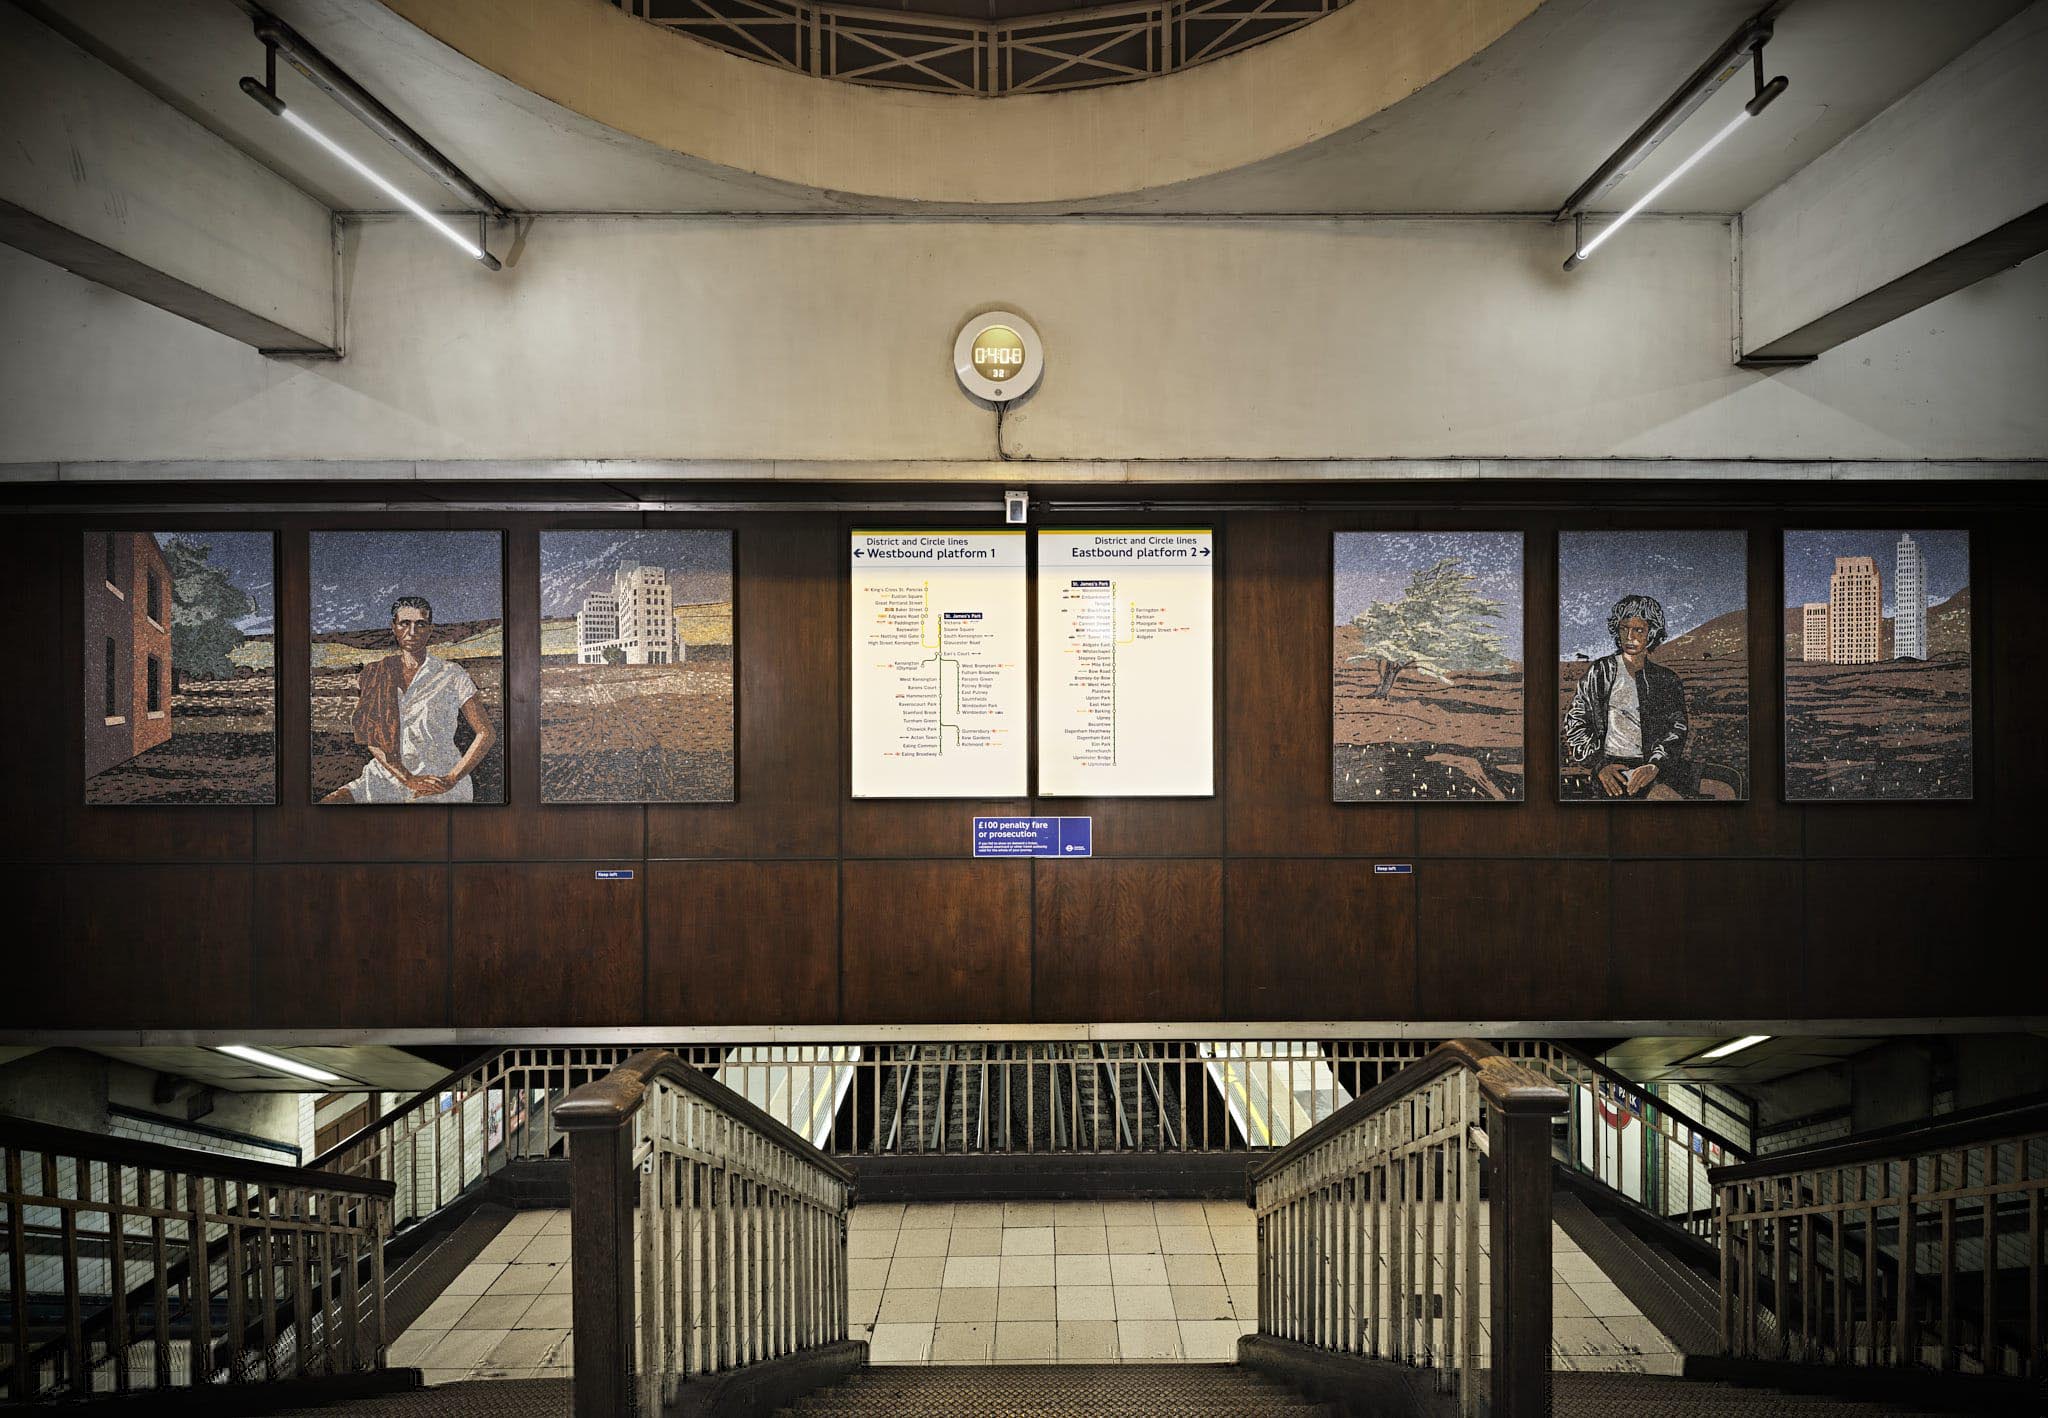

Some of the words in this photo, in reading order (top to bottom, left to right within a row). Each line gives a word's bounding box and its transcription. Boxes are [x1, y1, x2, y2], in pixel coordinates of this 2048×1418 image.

[867, 548, 932, 557] Westbound
[937, 548, 986, 560] platform
[992, 548, 995, 557] 1
[1072, 548, 1132, 556] Eastbound
[1137, 548, 1187, 559] platform
[1191, 548, 1197, 556] 2
[1000, 821, 1030, 830] penalty
[1618, 1086, 1637, 1108] PK
